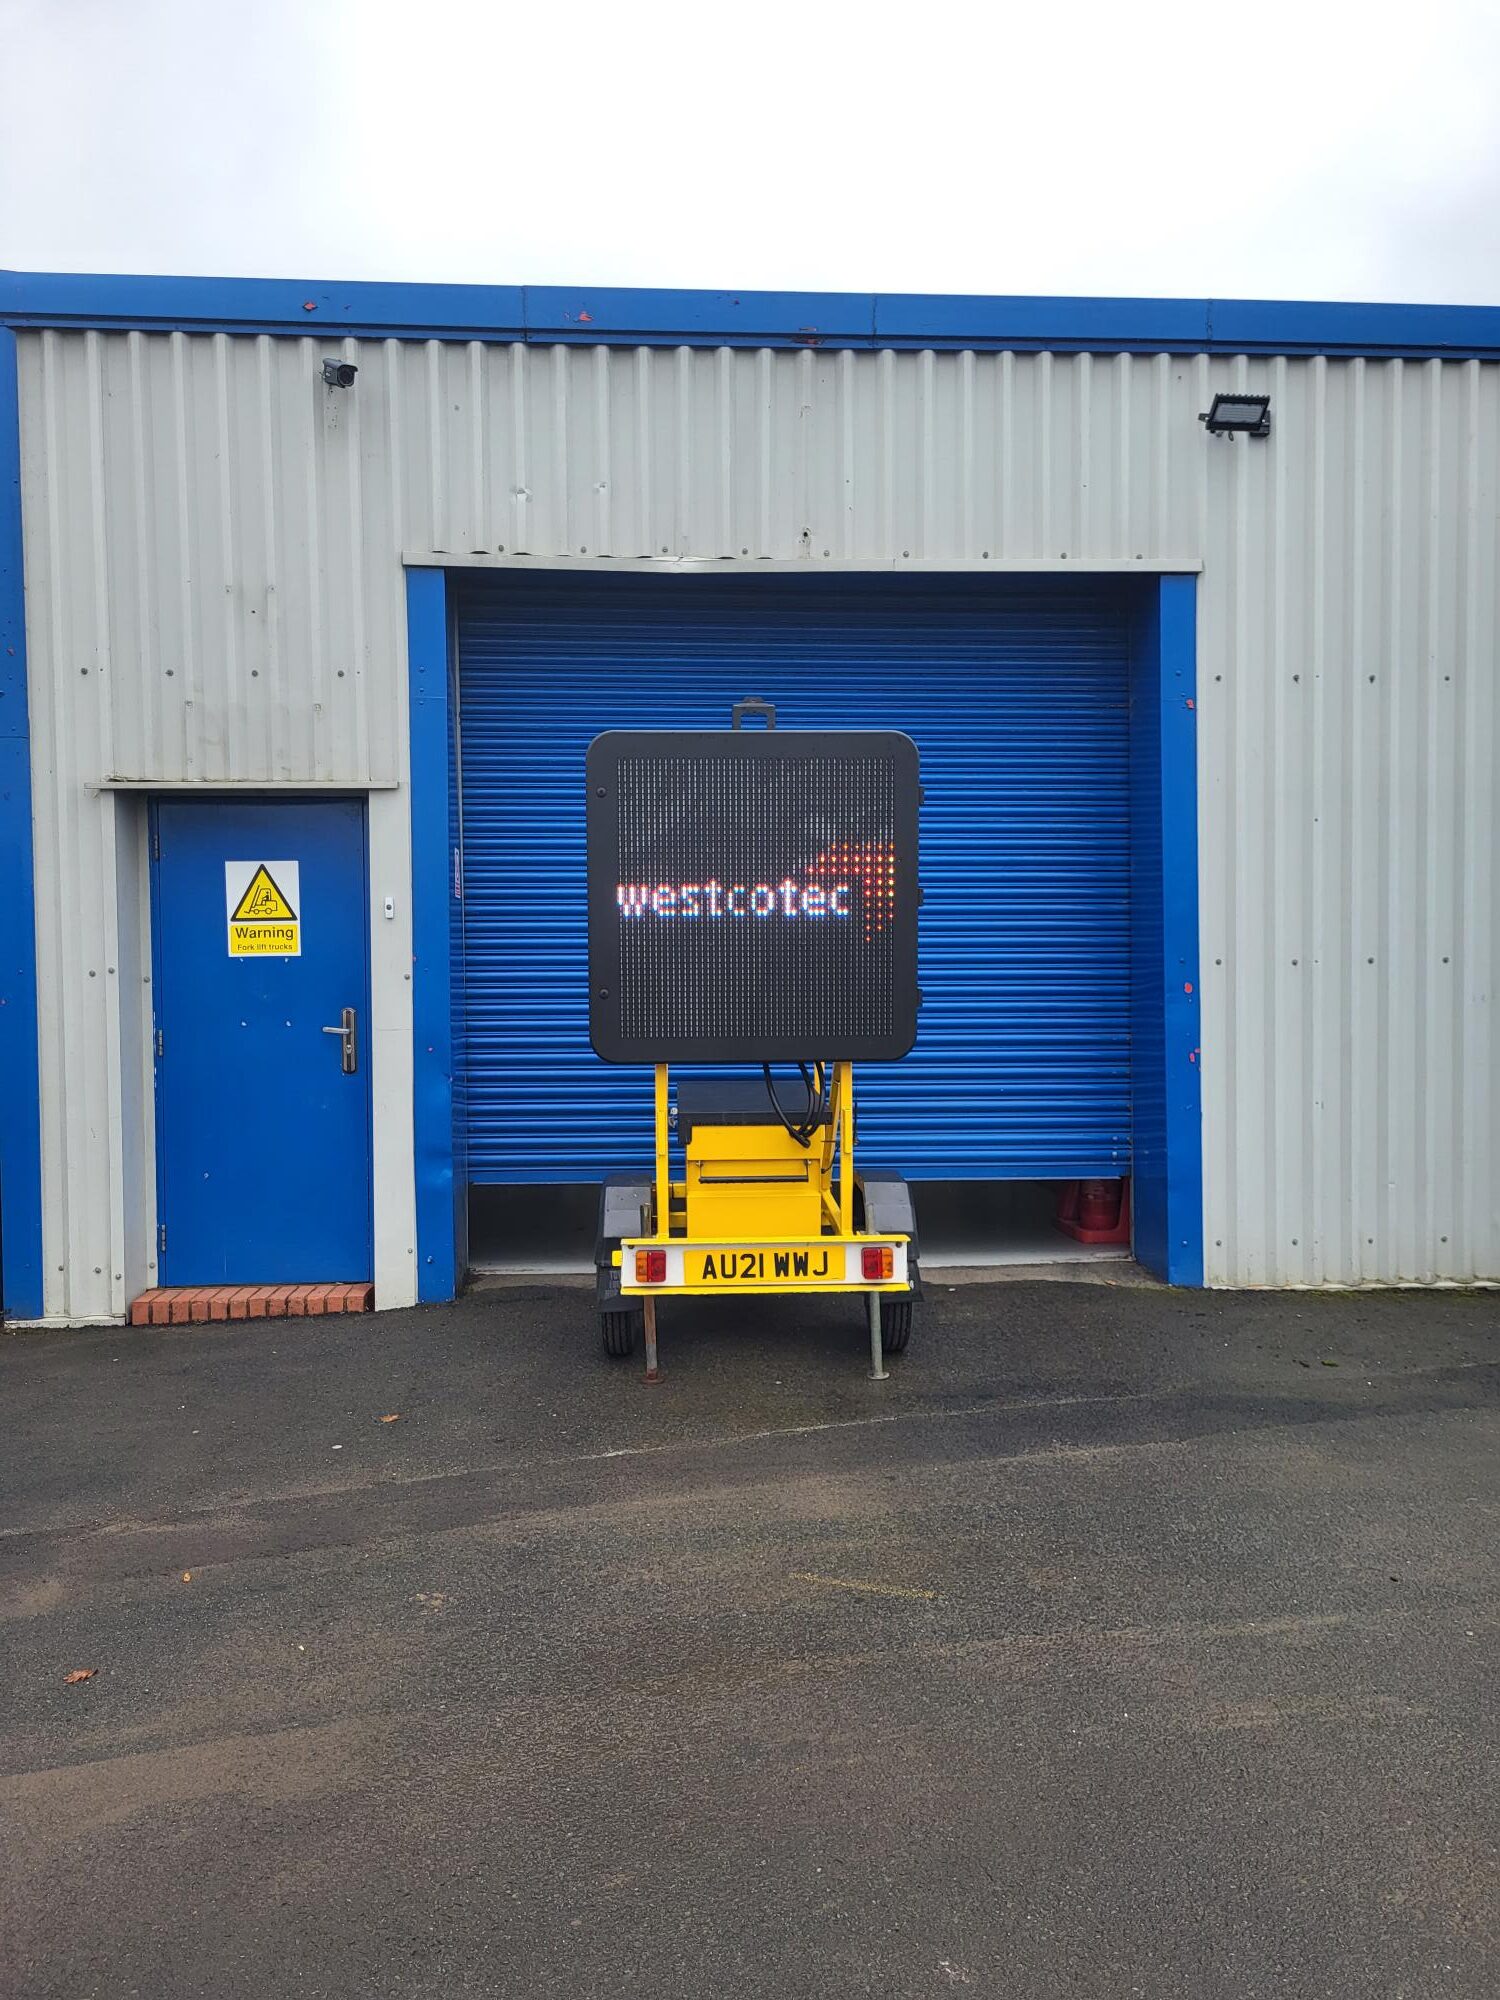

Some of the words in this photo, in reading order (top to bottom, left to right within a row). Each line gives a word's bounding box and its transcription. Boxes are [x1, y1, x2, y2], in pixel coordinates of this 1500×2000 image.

[617, 879, 848, 916] westcotec
[235, 927, 294, 941] Warning
[702, 1253, 765, 1279] AU21
[774, 1251, 828, 1277] WWJ
